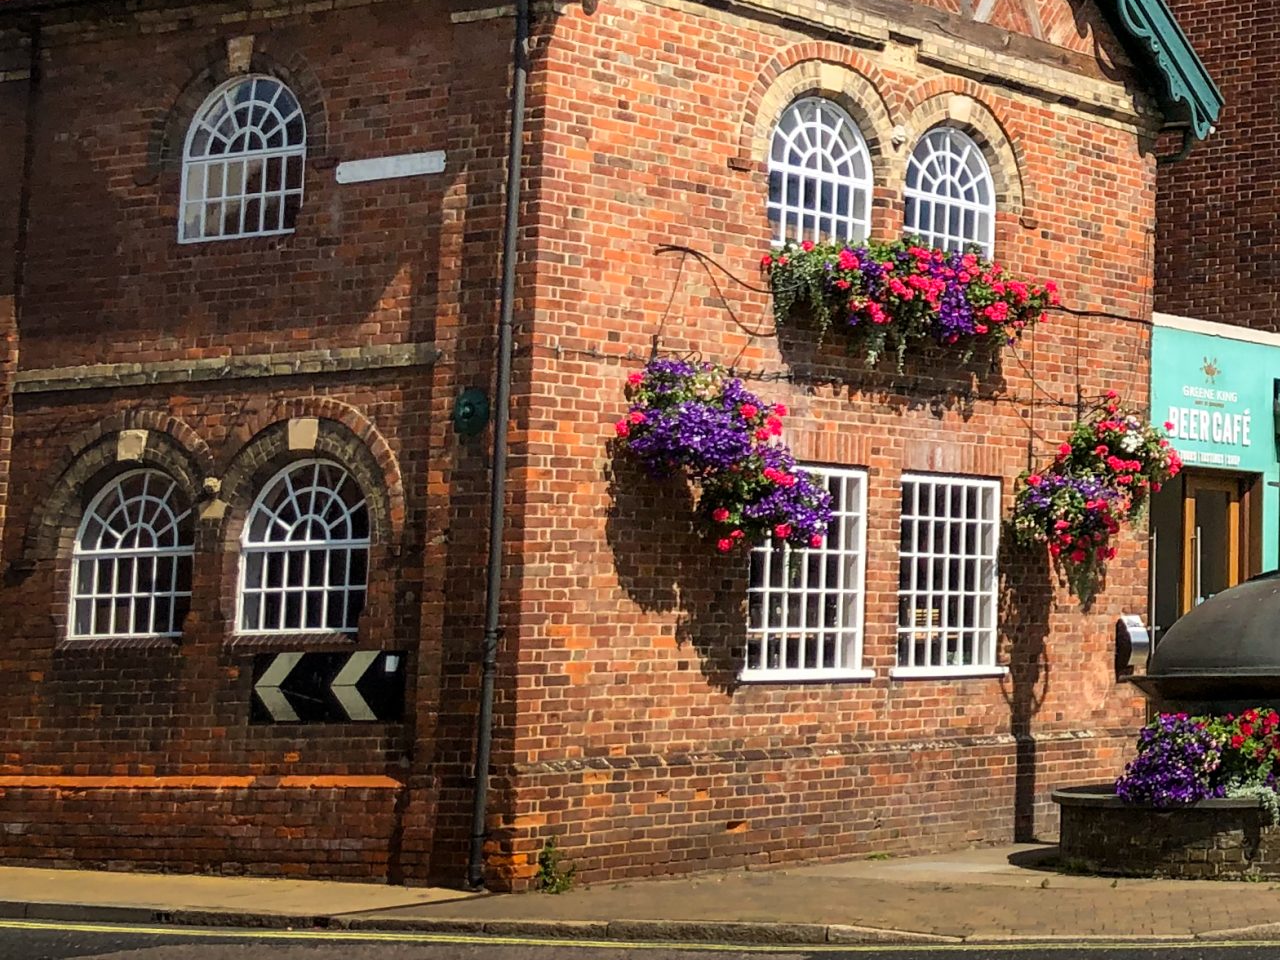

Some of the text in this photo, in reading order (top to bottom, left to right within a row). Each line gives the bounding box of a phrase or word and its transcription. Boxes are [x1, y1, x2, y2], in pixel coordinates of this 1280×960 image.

[1183, 386, 1238, 402] GREENE KING
[1168, 406, 1251, 446] BEER CAFÉ
